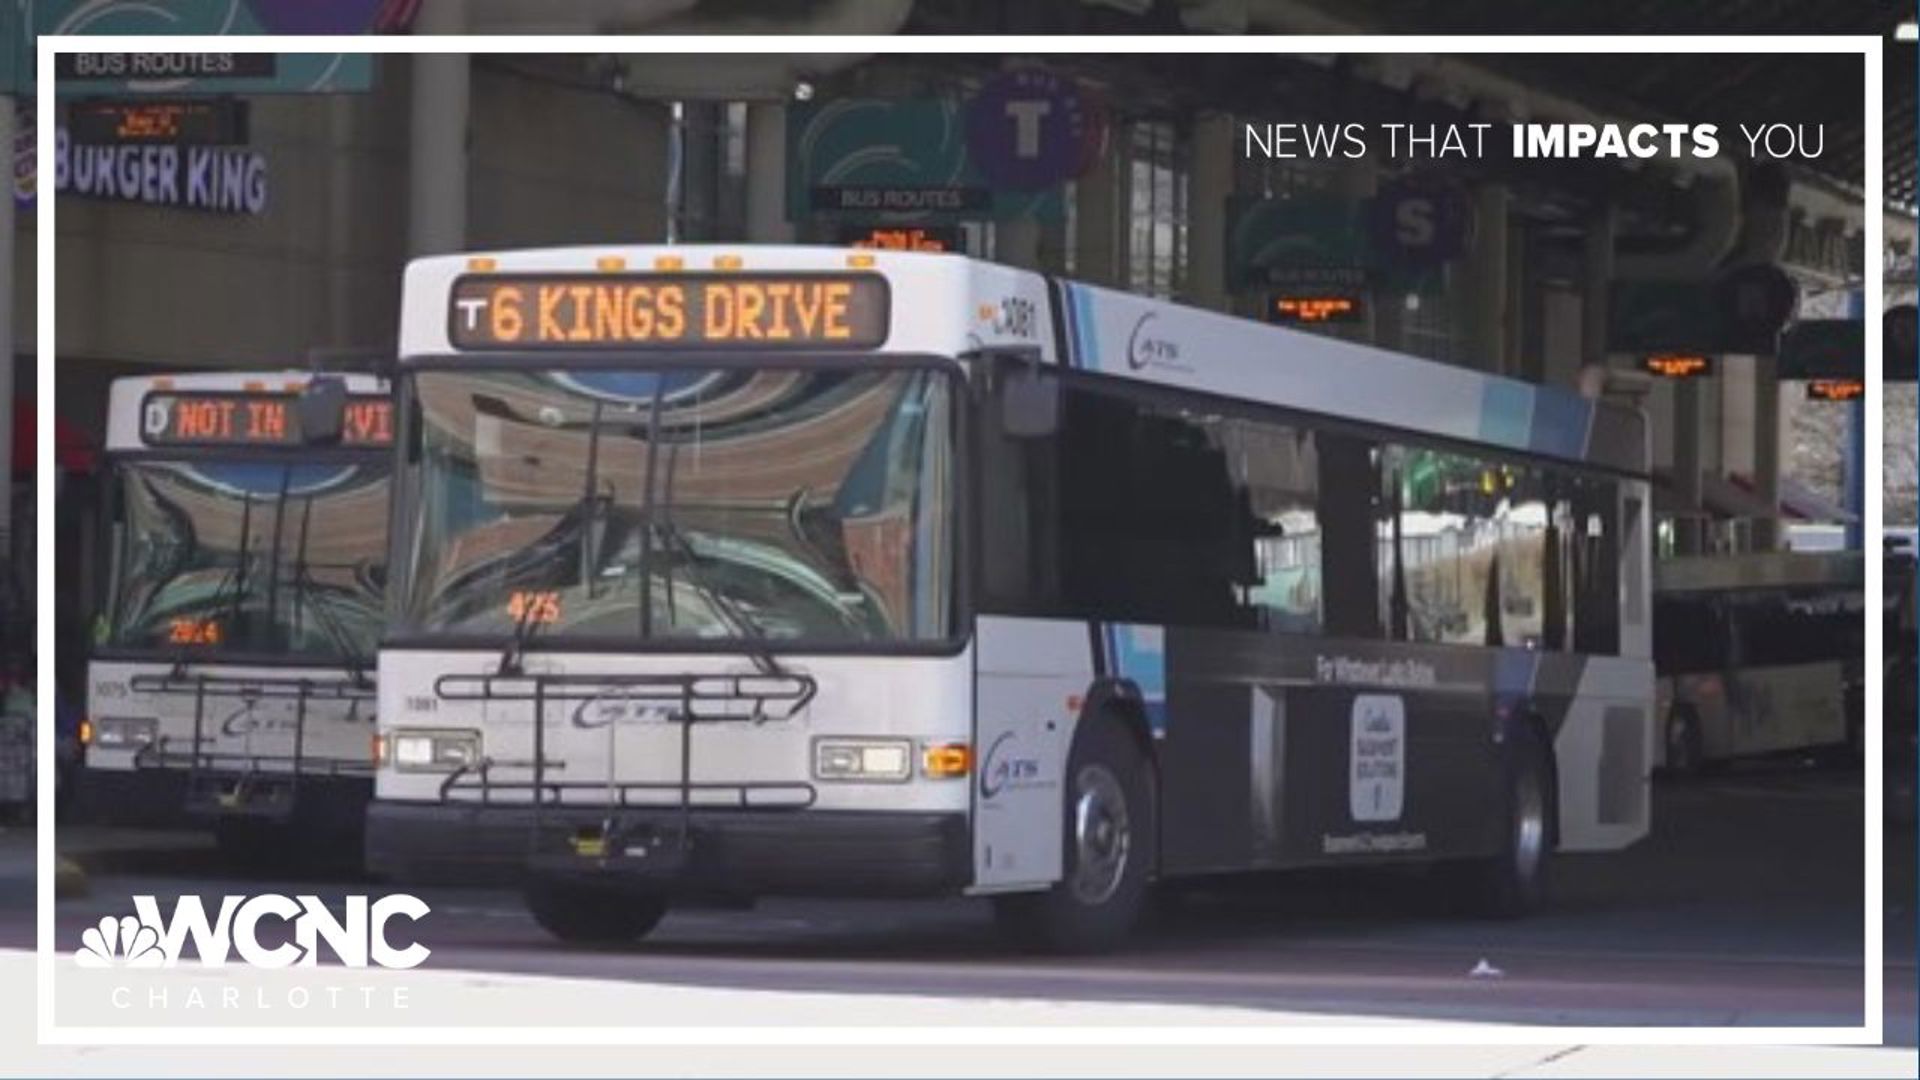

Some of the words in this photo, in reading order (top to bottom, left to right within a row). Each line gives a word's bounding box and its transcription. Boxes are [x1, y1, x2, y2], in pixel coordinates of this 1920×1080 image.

[75, 53, 125, 74] BUS
[134, 53, 233, 73] ROUTES
[1005, 100, 1051, 158] T
[54, 128, 179, 202] BURGER
[187, 148, 267, 213] KING
[841, 190, 885, 207] BUS
[885, 190, 960, 206] ROUTES
[1396, 201, 1434, 245] S
[491, 286, 521, 342] 6
[537, 285, 684, 341] KINGS
[704, 283, 850, 340] DRIVE
[177, 402, 234, 438] NOT
[248, 402, 284, 438] IN
